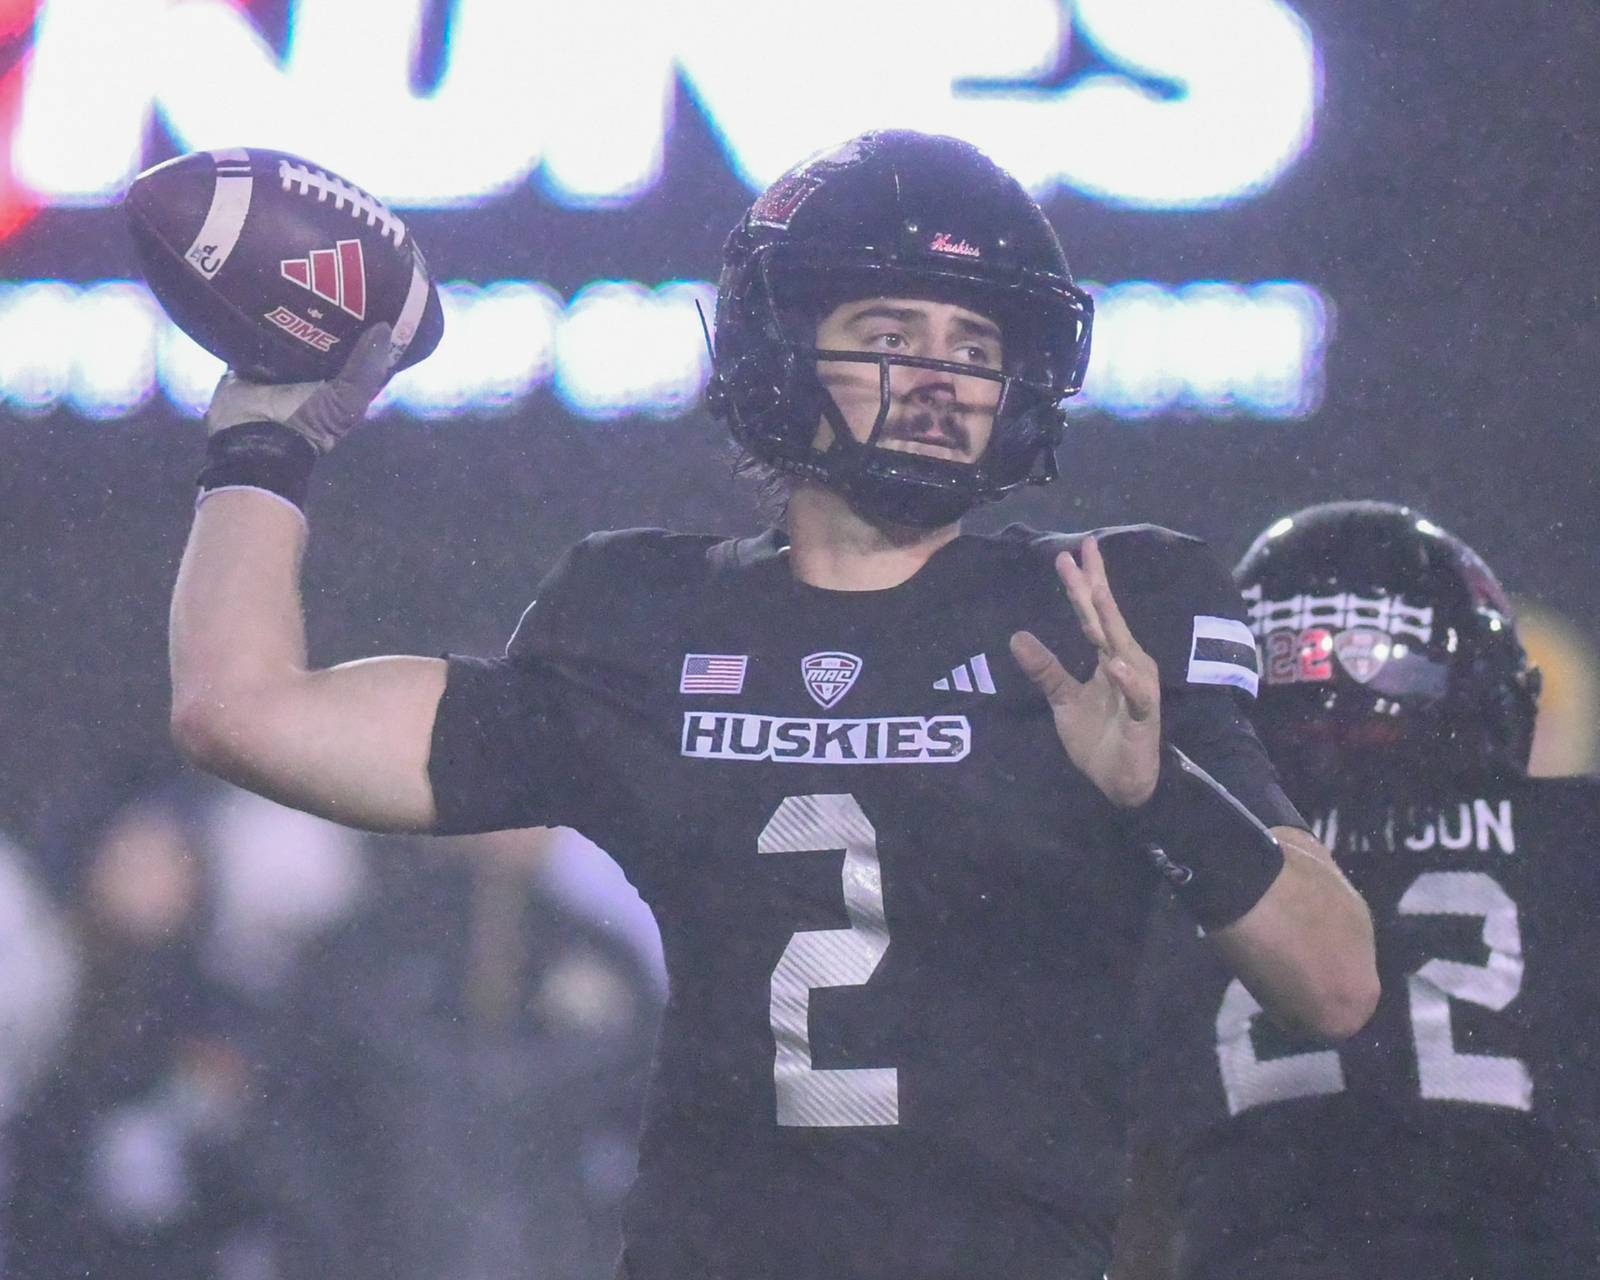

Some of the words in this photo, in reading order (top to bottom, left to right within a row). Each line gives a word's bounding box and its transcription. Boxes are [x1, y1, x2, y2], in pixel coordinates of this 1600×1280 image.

[264, 306, 340, 352] DIME
[806, 669, 853, 682] MAC
[1266, 628, 1333, 684] 22
[681, 711, 971, 764] HUSKIES
[757, 793, 899, 1127] 2
